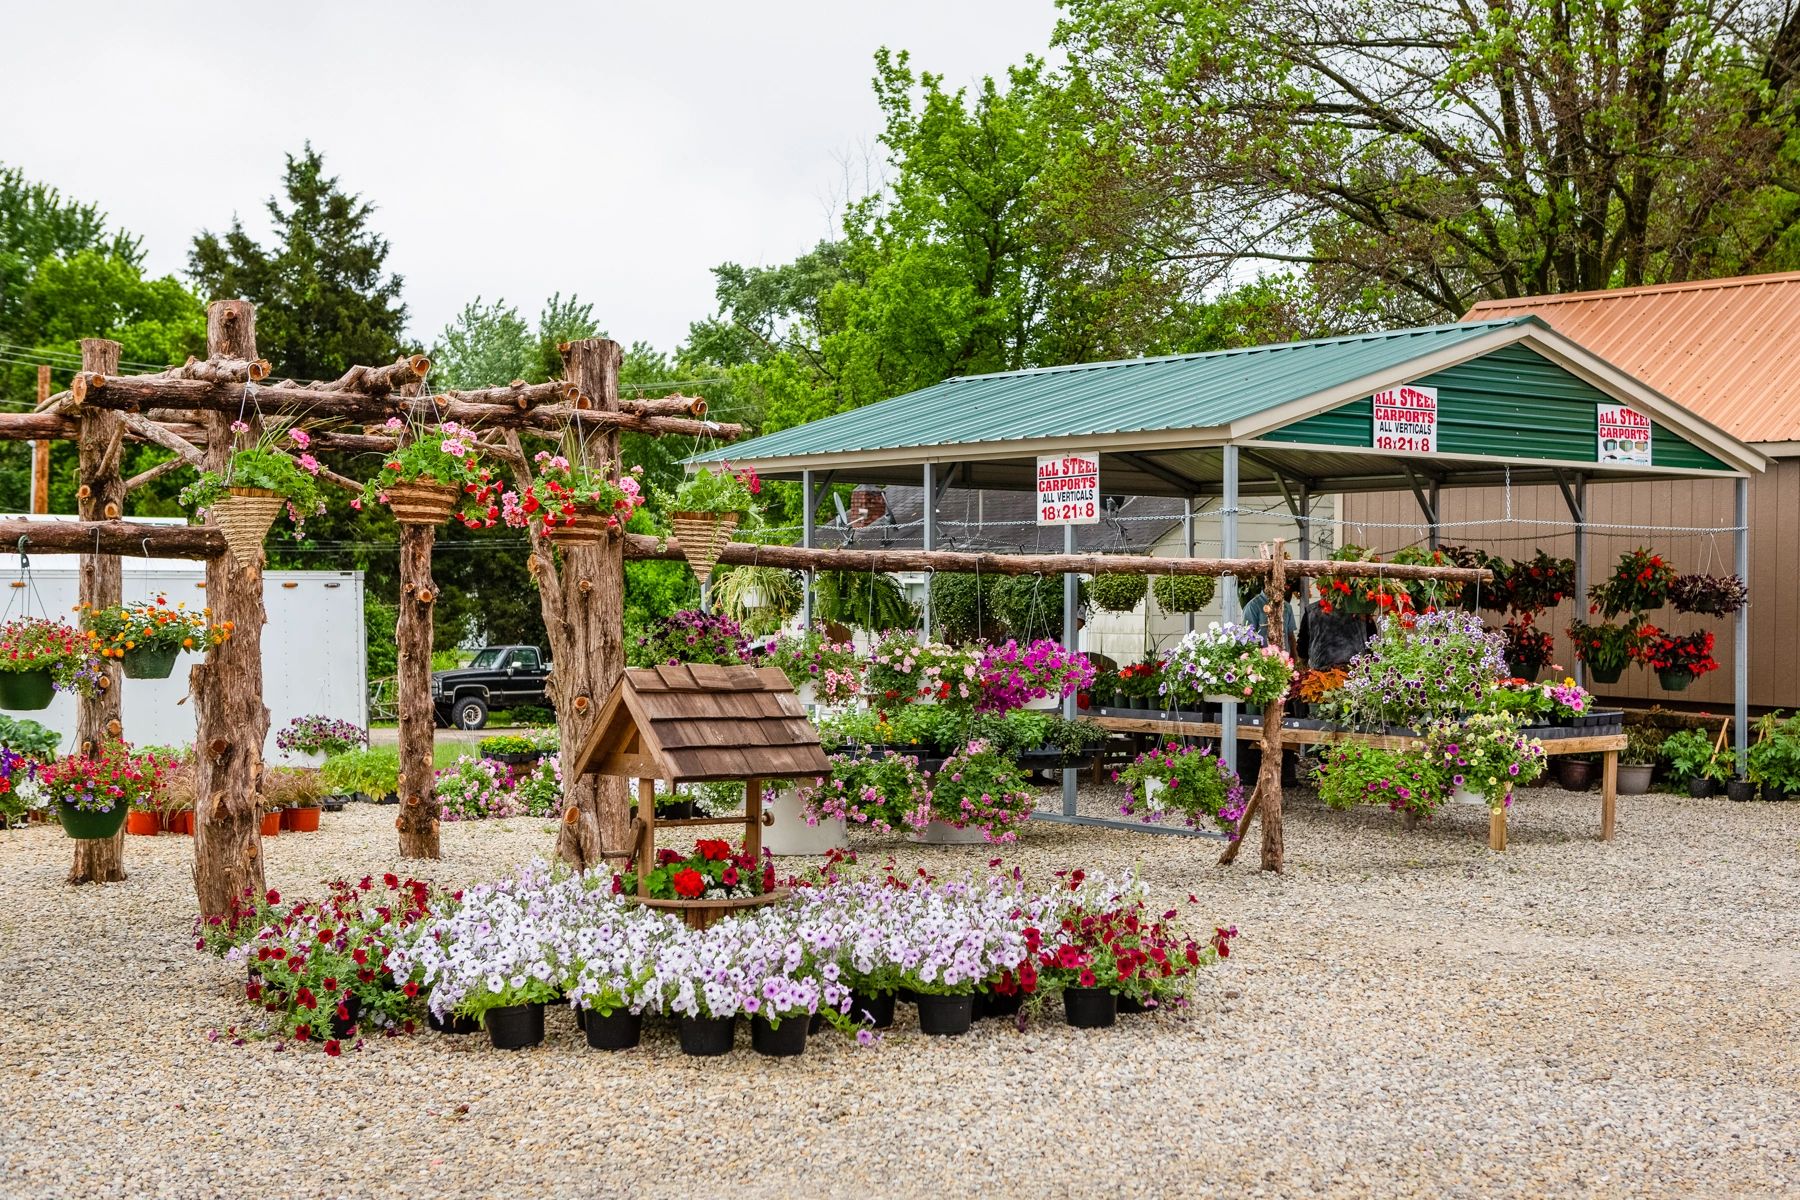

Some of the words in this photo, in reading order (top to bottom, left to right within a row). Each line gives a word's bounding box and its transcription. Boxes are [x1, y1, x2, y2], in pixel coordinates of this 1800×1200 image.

[1374, 391, 1397, 406] ALL
[1400, 388, 1435, 408] STEEL
[1375, 408, 1434, 424] CARPORTS
[1600, 410, 1617, 424] ALL
[1620, 408, 1649, 426] STEEL
[1380, 421, 1392, 432] ALL
[1395, 422, 1431, 435] VERTICALS
[1600, 427, 1649, 440] CARPORTS
[1039, 462, 1058, 477] ALL
[1062, 457, 1097, 475] STEEL
[1039, 477, 1096, 492] CARPORTS
[1043, 492, 1054, 503] ALL
[1057, 490, 1093, 502] VERTICALS
